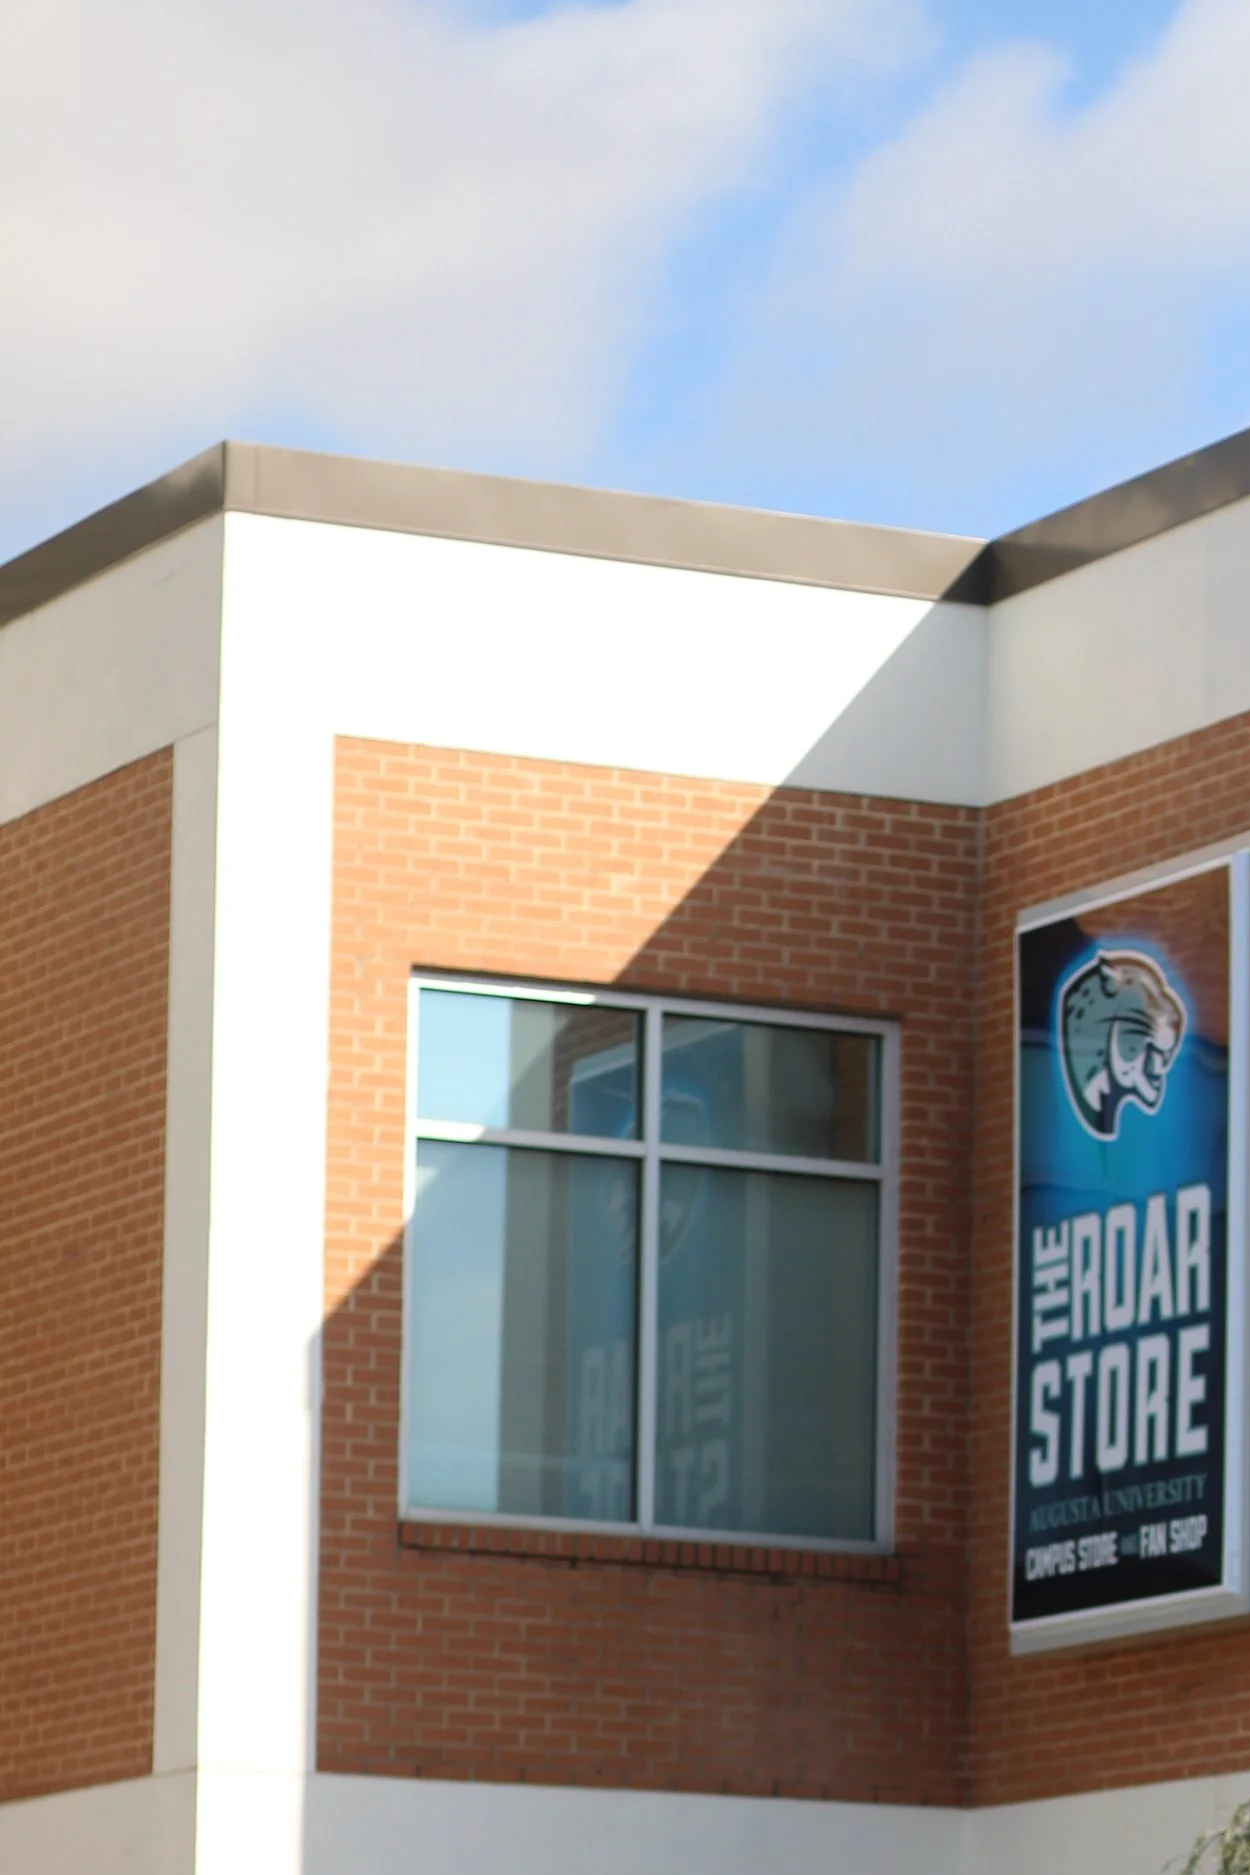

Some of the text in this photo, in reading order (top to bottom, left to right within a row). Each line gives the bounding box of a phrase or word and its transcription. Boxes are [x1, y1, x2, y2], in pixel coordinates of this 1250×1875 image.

[1032, 1182, 1211, 1354] THE ROAR
[1029, 1322, 1211, 1488] STORE
[1026, 1538, 1077, 1581] CAMPUS
[1078, 1531, 1119, 1571] STORE
[1140, 1521, 1168, 1559] FAN
[1169, 1514, 1208, 1554] SHOP
[1029, 1473, 1207, 1532] AUGUSTA UNIVERSITY
